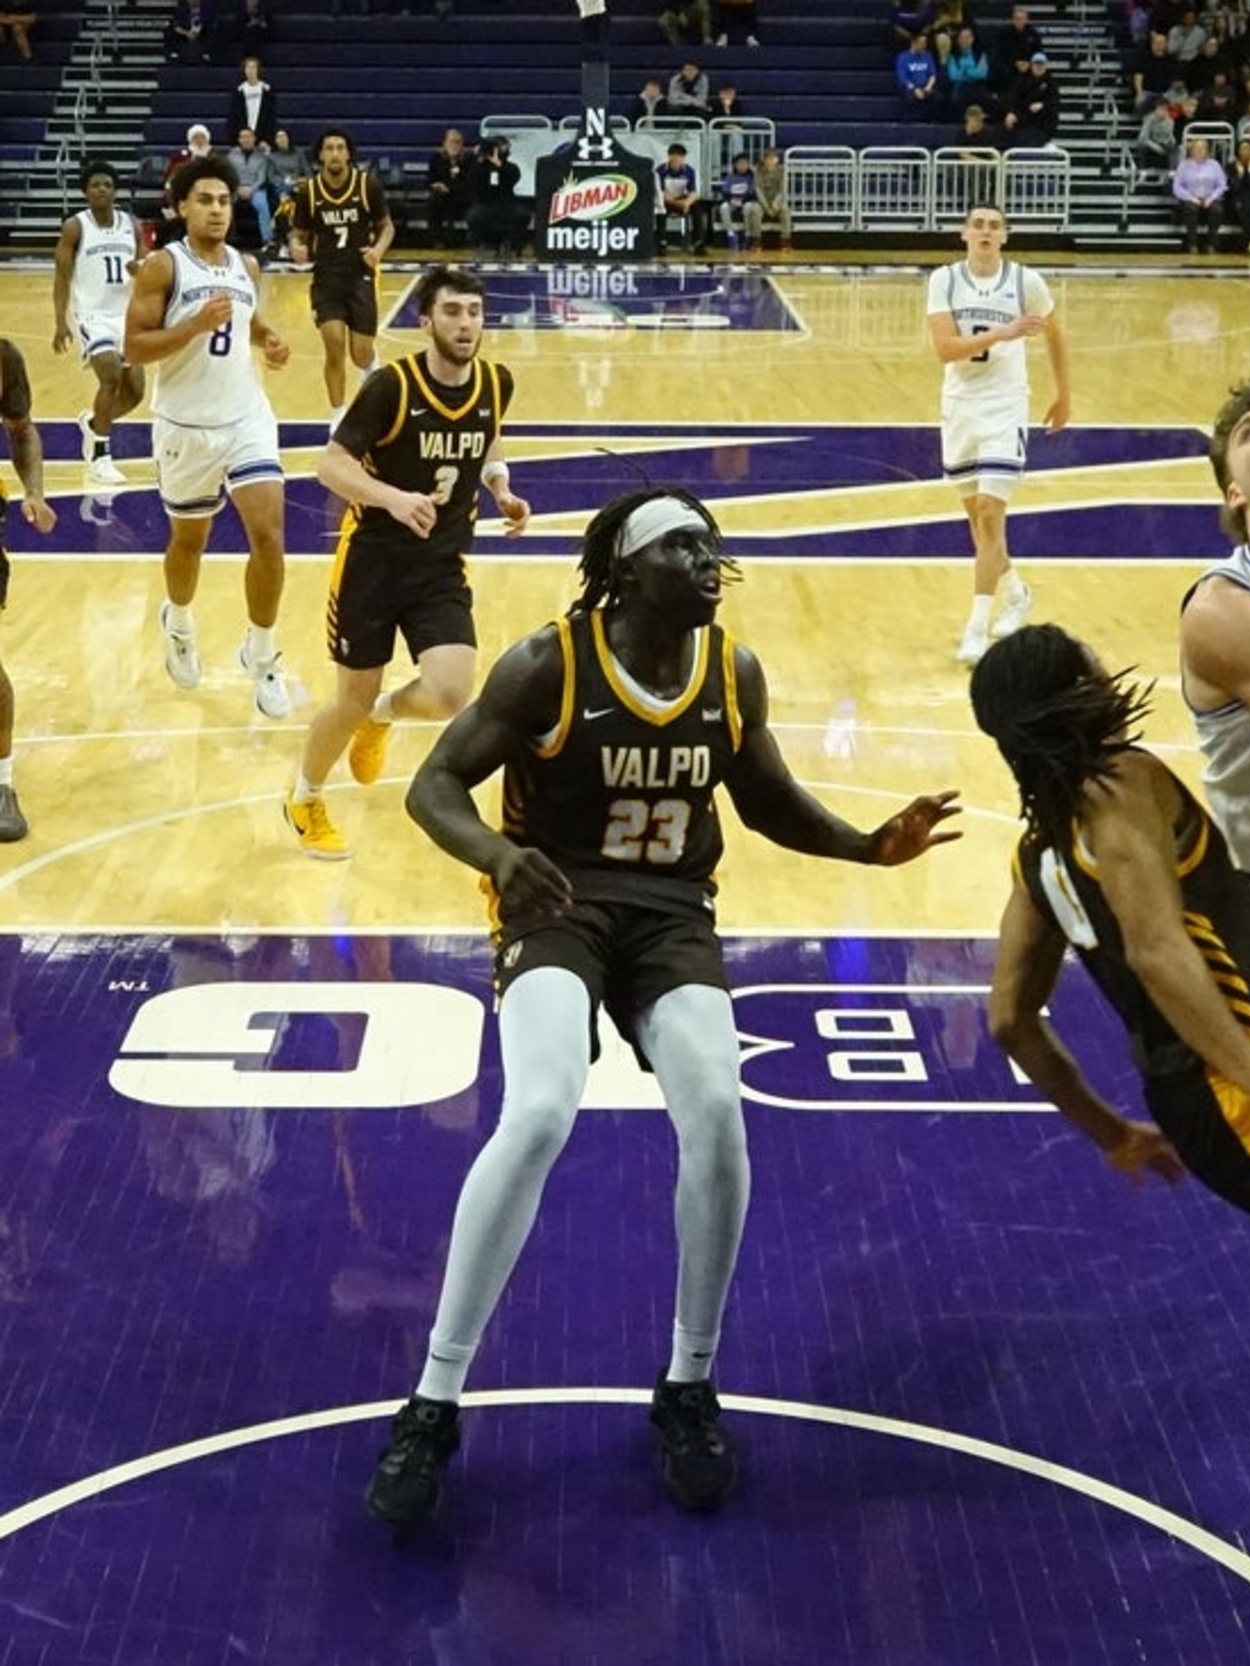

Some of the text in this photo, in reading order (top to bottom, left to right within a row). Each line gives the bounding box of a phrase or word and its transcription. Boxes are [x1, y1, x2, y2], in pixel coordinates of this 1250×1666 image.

[586, 107, 605, 136] N
[550, 182, 629, 220] LIBMAN
[334, 227, 348, 249] 7
[547, 220, 640, 257] meijer
[103, 256, 123, 284] 11
[420, 431, 485, 459] VALPO
[601, 745, 710, 788] VALPO
[601, 799, 692, 863] 23
